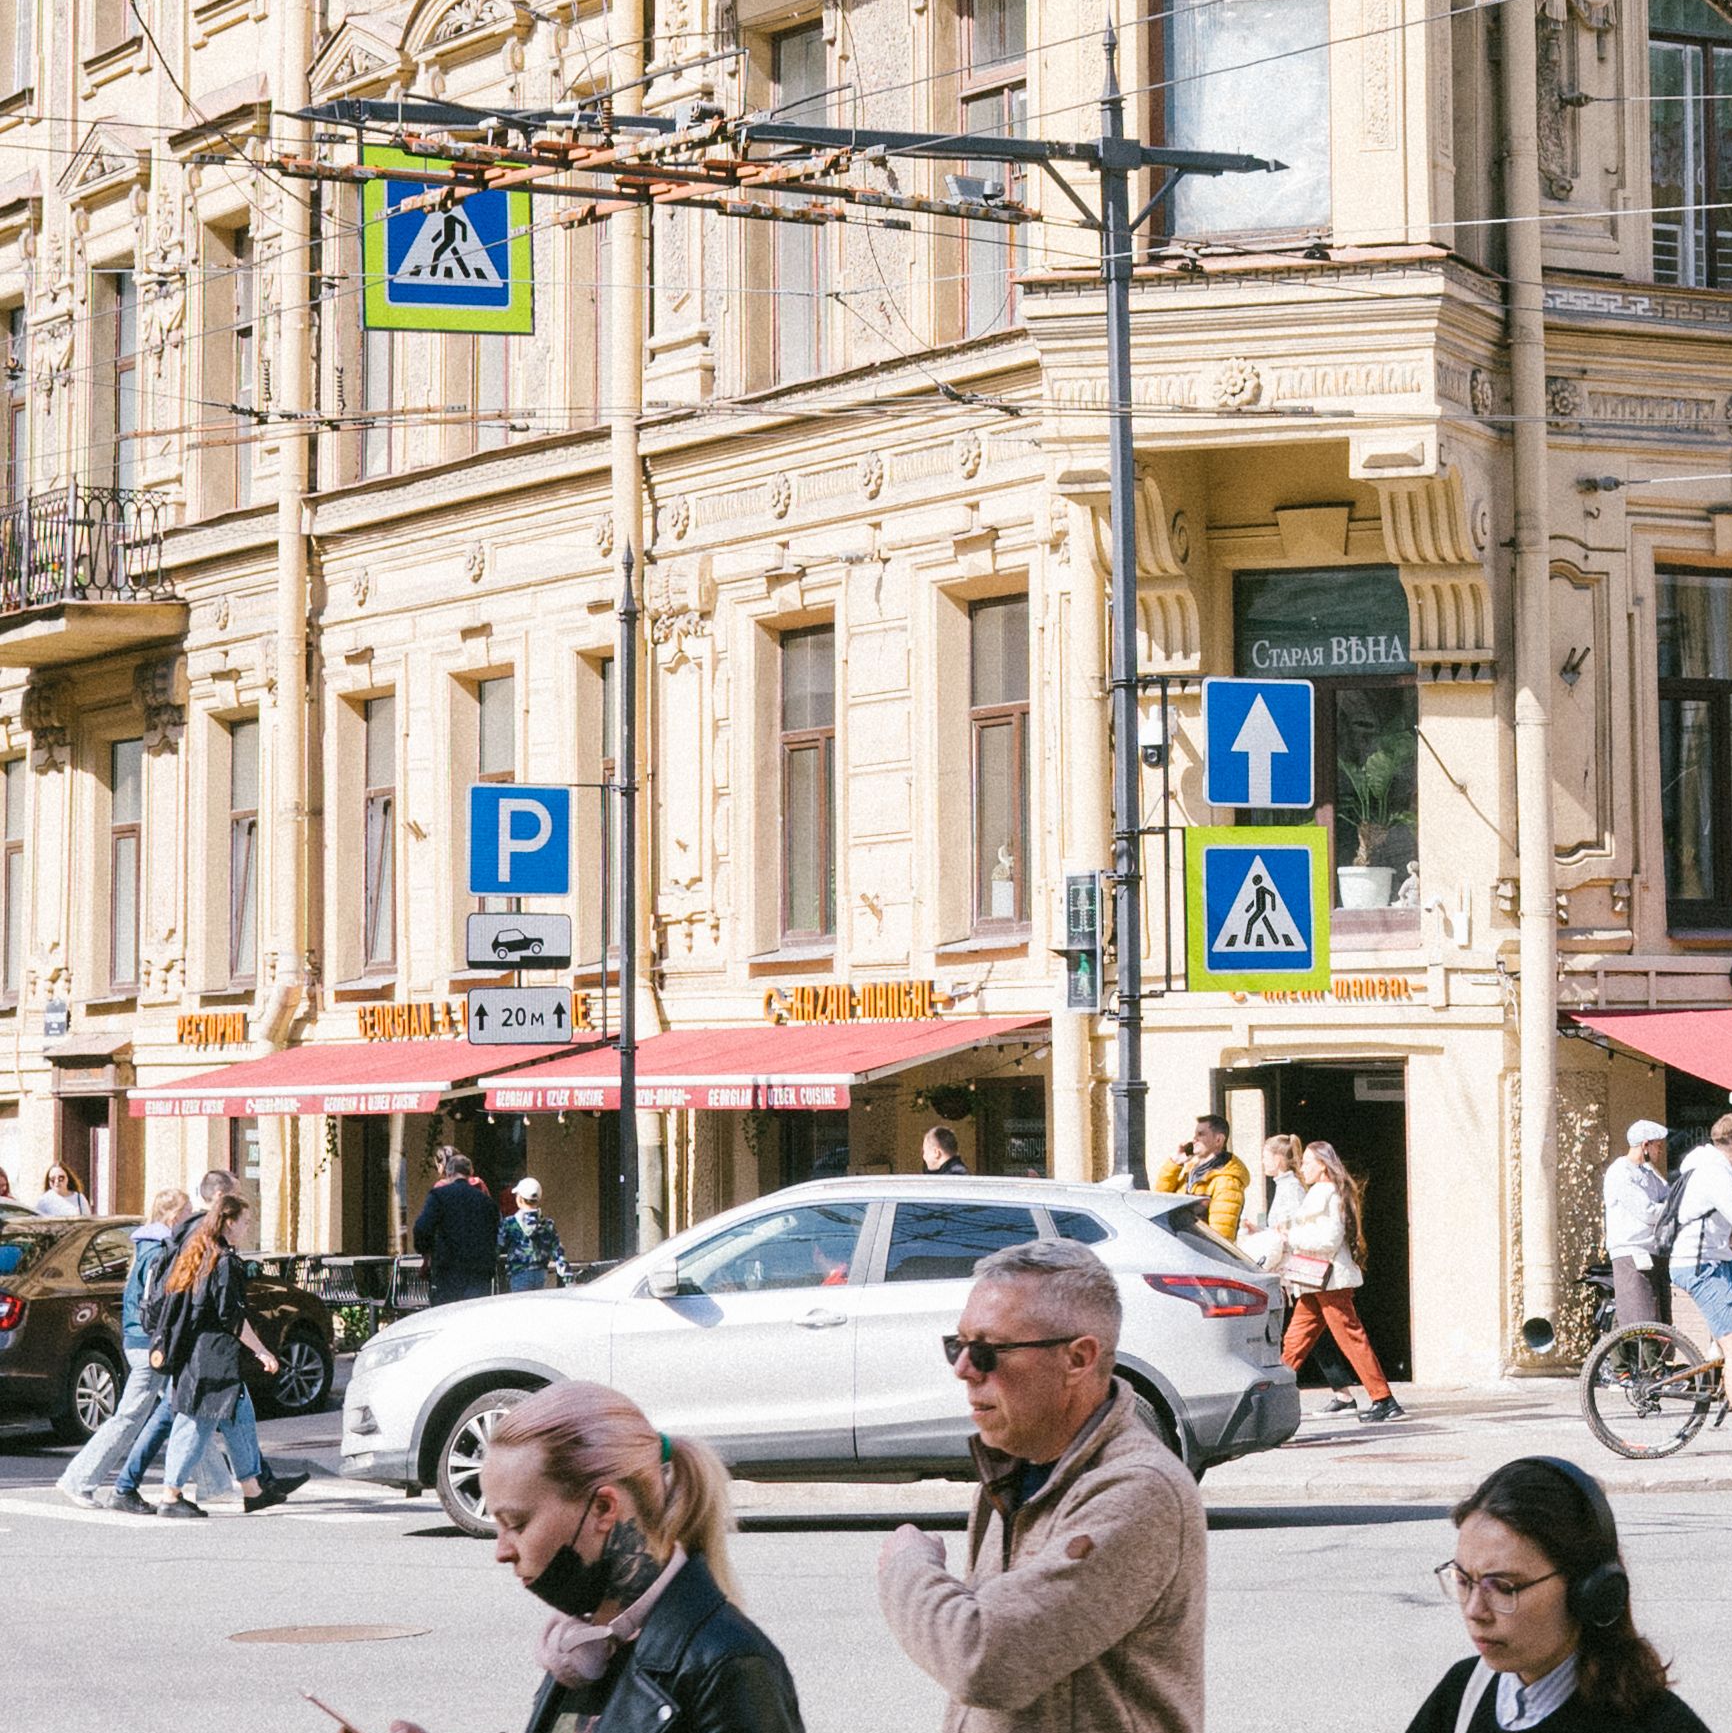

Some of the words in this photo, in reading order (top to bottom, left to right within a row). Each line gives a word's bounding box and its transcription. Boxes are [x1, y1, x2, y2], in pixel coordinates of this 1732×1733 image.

[498, 798, 553, 883] P
[177, 1012, 247, 1045] РЕСТОРАН
[356, 1003, 432, 1038] GEORGIAN
[496, 1090, 535, 1107] GEORGIAN
[573, 1088, 605, 1106] CUISINE
[708, 1088, 752, 1107] GEORGIAN
[767, 1087, 797, 1106] UZBEK
[800, 1086, 837, 1106] CUISINE
